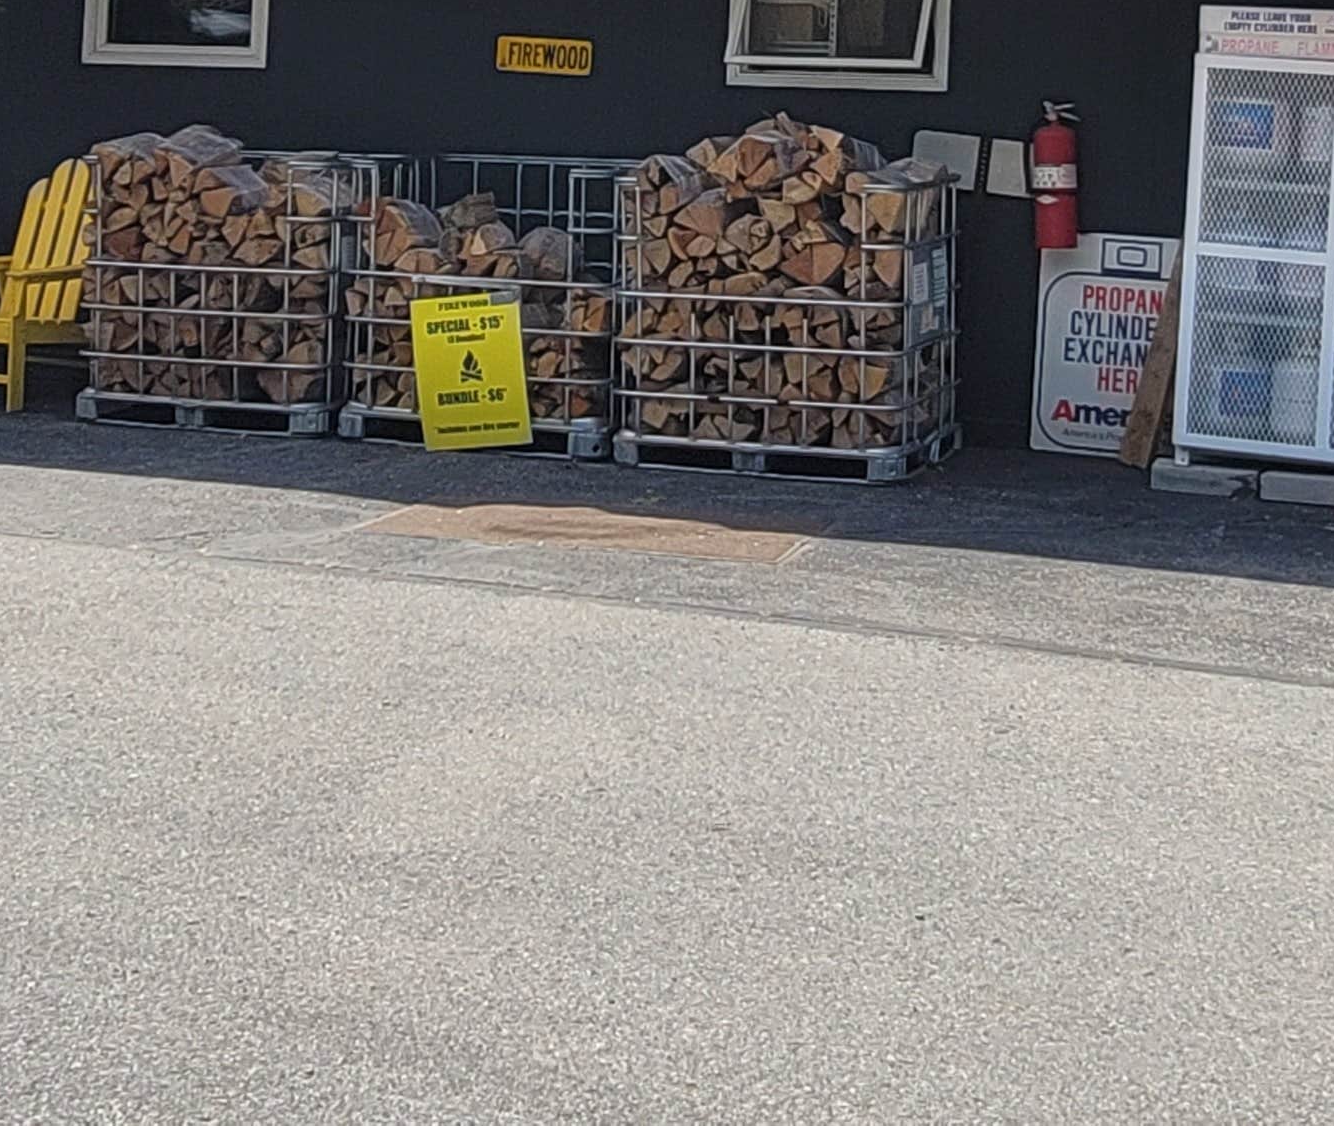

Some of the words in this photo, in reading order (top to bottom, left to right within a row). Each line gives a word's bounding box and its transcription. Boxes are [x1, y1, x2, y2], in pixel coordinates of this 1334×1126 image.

[508, 41, 590, 70] FIREWOOD
[1220, 38, 1280, 54] PROPANE
[1082, 284, 1164, 314] PROPAN
[426, 318, 471, 335] SPECIAL
[1070, 310, 1158, 341] CYLINDE
[1063, 337, 1151, 368] EXCHAN
[1096, 367, 1138, 395] HER
[437, 390, 480, 406] BUNDLE
[1050, 399, 1133, 428] Amer
